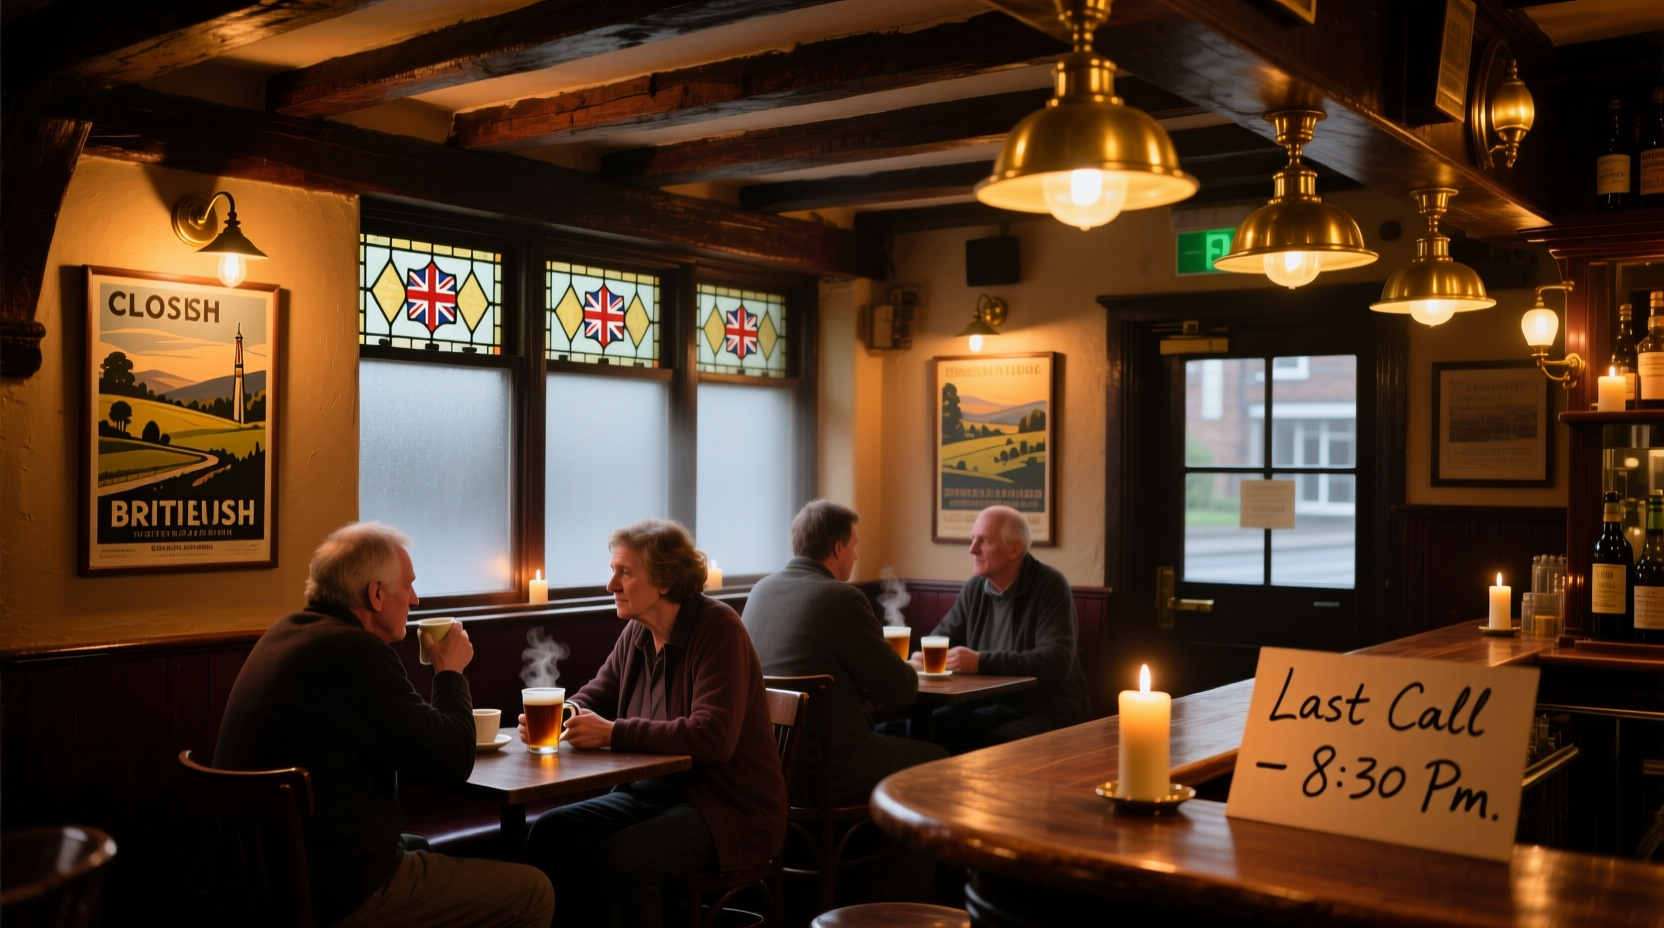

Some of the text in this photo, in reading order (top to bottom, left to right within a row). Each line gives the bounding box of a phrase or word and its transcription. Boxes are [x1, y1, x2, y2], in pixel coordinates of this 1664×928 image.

[1269, 667, 1491, 737] Last Call
[1302, 745, 1406, 799] 8:30
